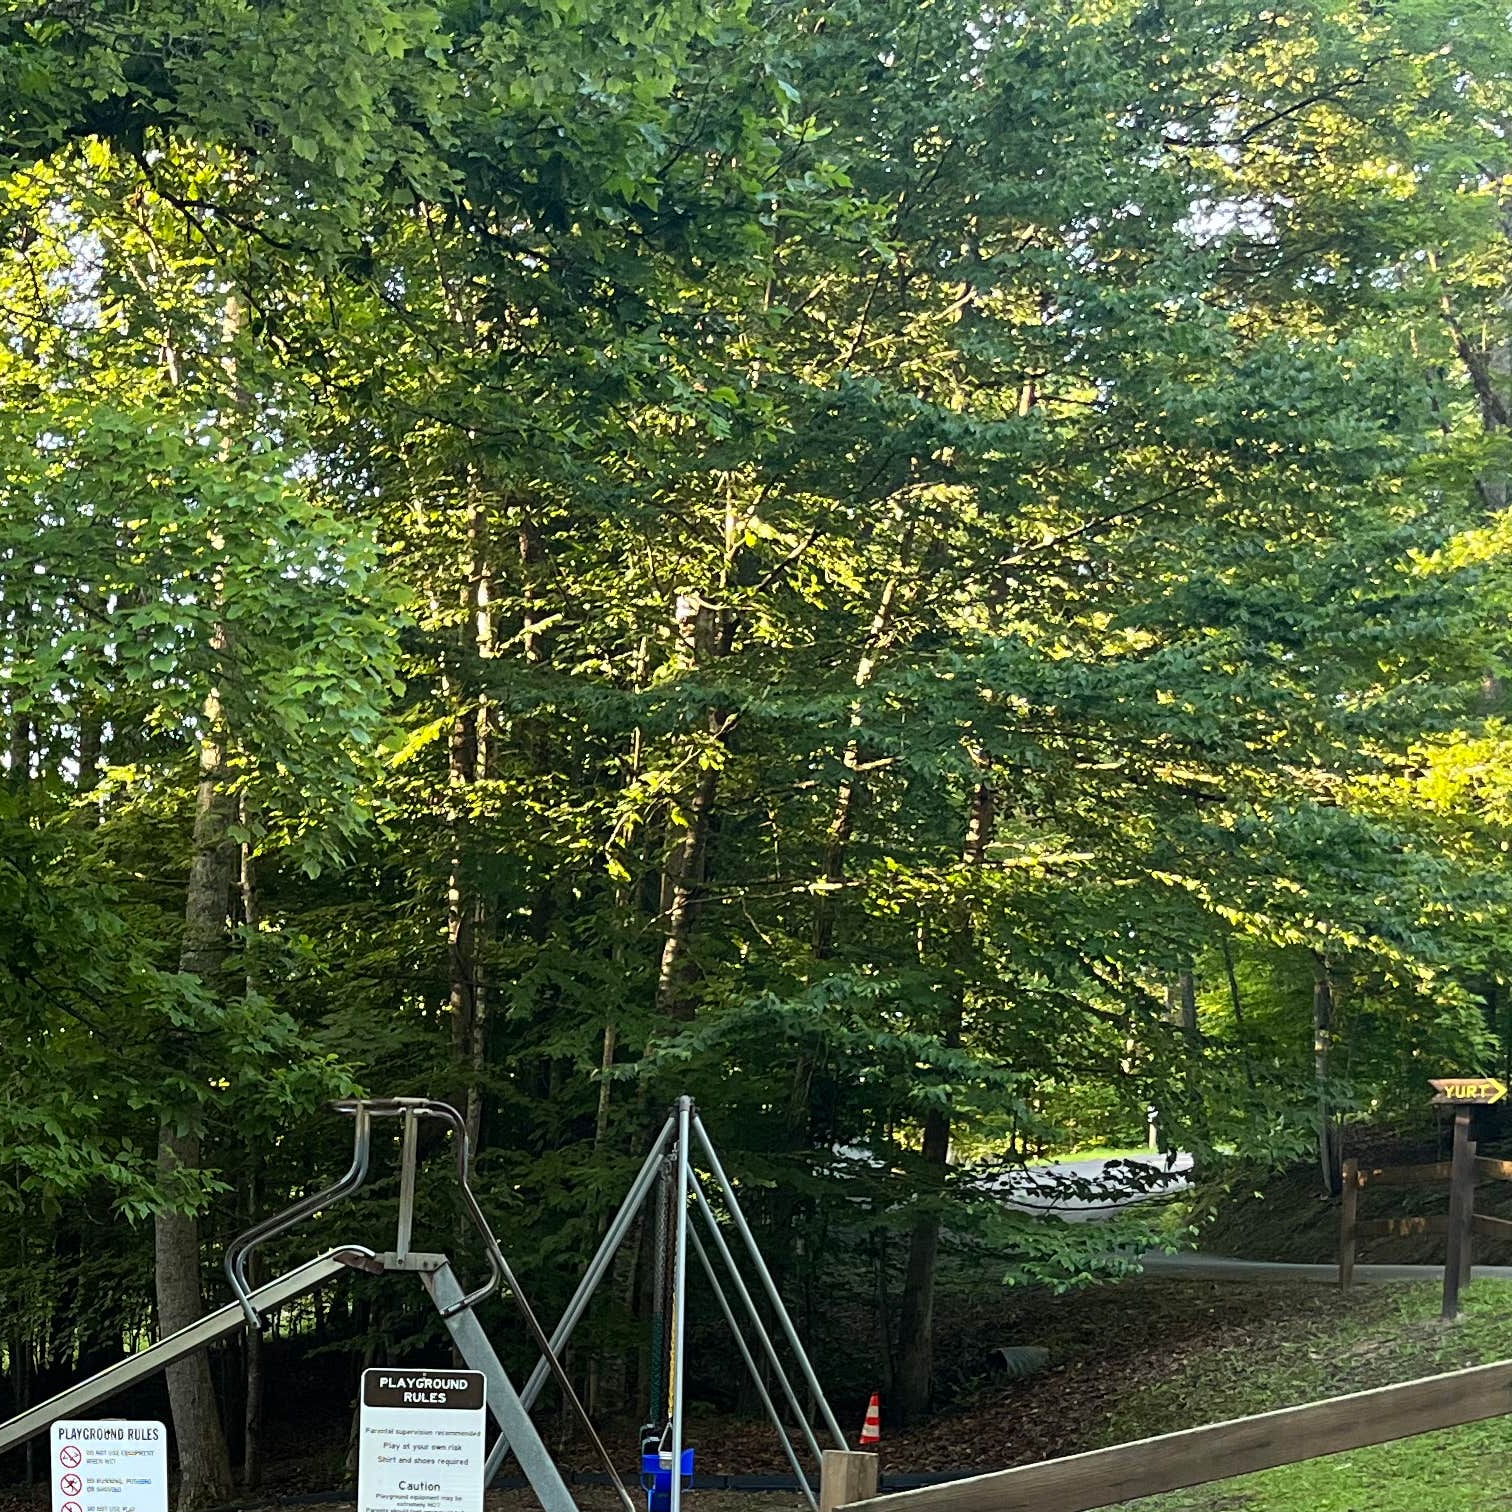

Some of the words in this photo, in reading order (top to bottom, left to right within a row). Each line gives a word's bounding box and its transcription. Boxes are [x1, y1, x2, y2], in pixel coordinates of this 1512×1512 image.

[1444, 1084, 1489, 1099] YURT
[379, 1377, 468, 1390] PLAYGROUND
[403, 1392, 447, 1403] RULES
[58, 1428, 124, 1441] PLAYGROUND
[127, 1428, 159, 1441] RULES
[365, 1427, 394, 1435] Parental
[383, 1442, 400, 1450] Play
[413, 1444, 429, 1452] your
[377, 1455, 396, 1463] Shirt
[398, 1456, 412, 1464] and
[437, 1458, 469, 1466] required
[398, 1480, 441, 1491] Caution
